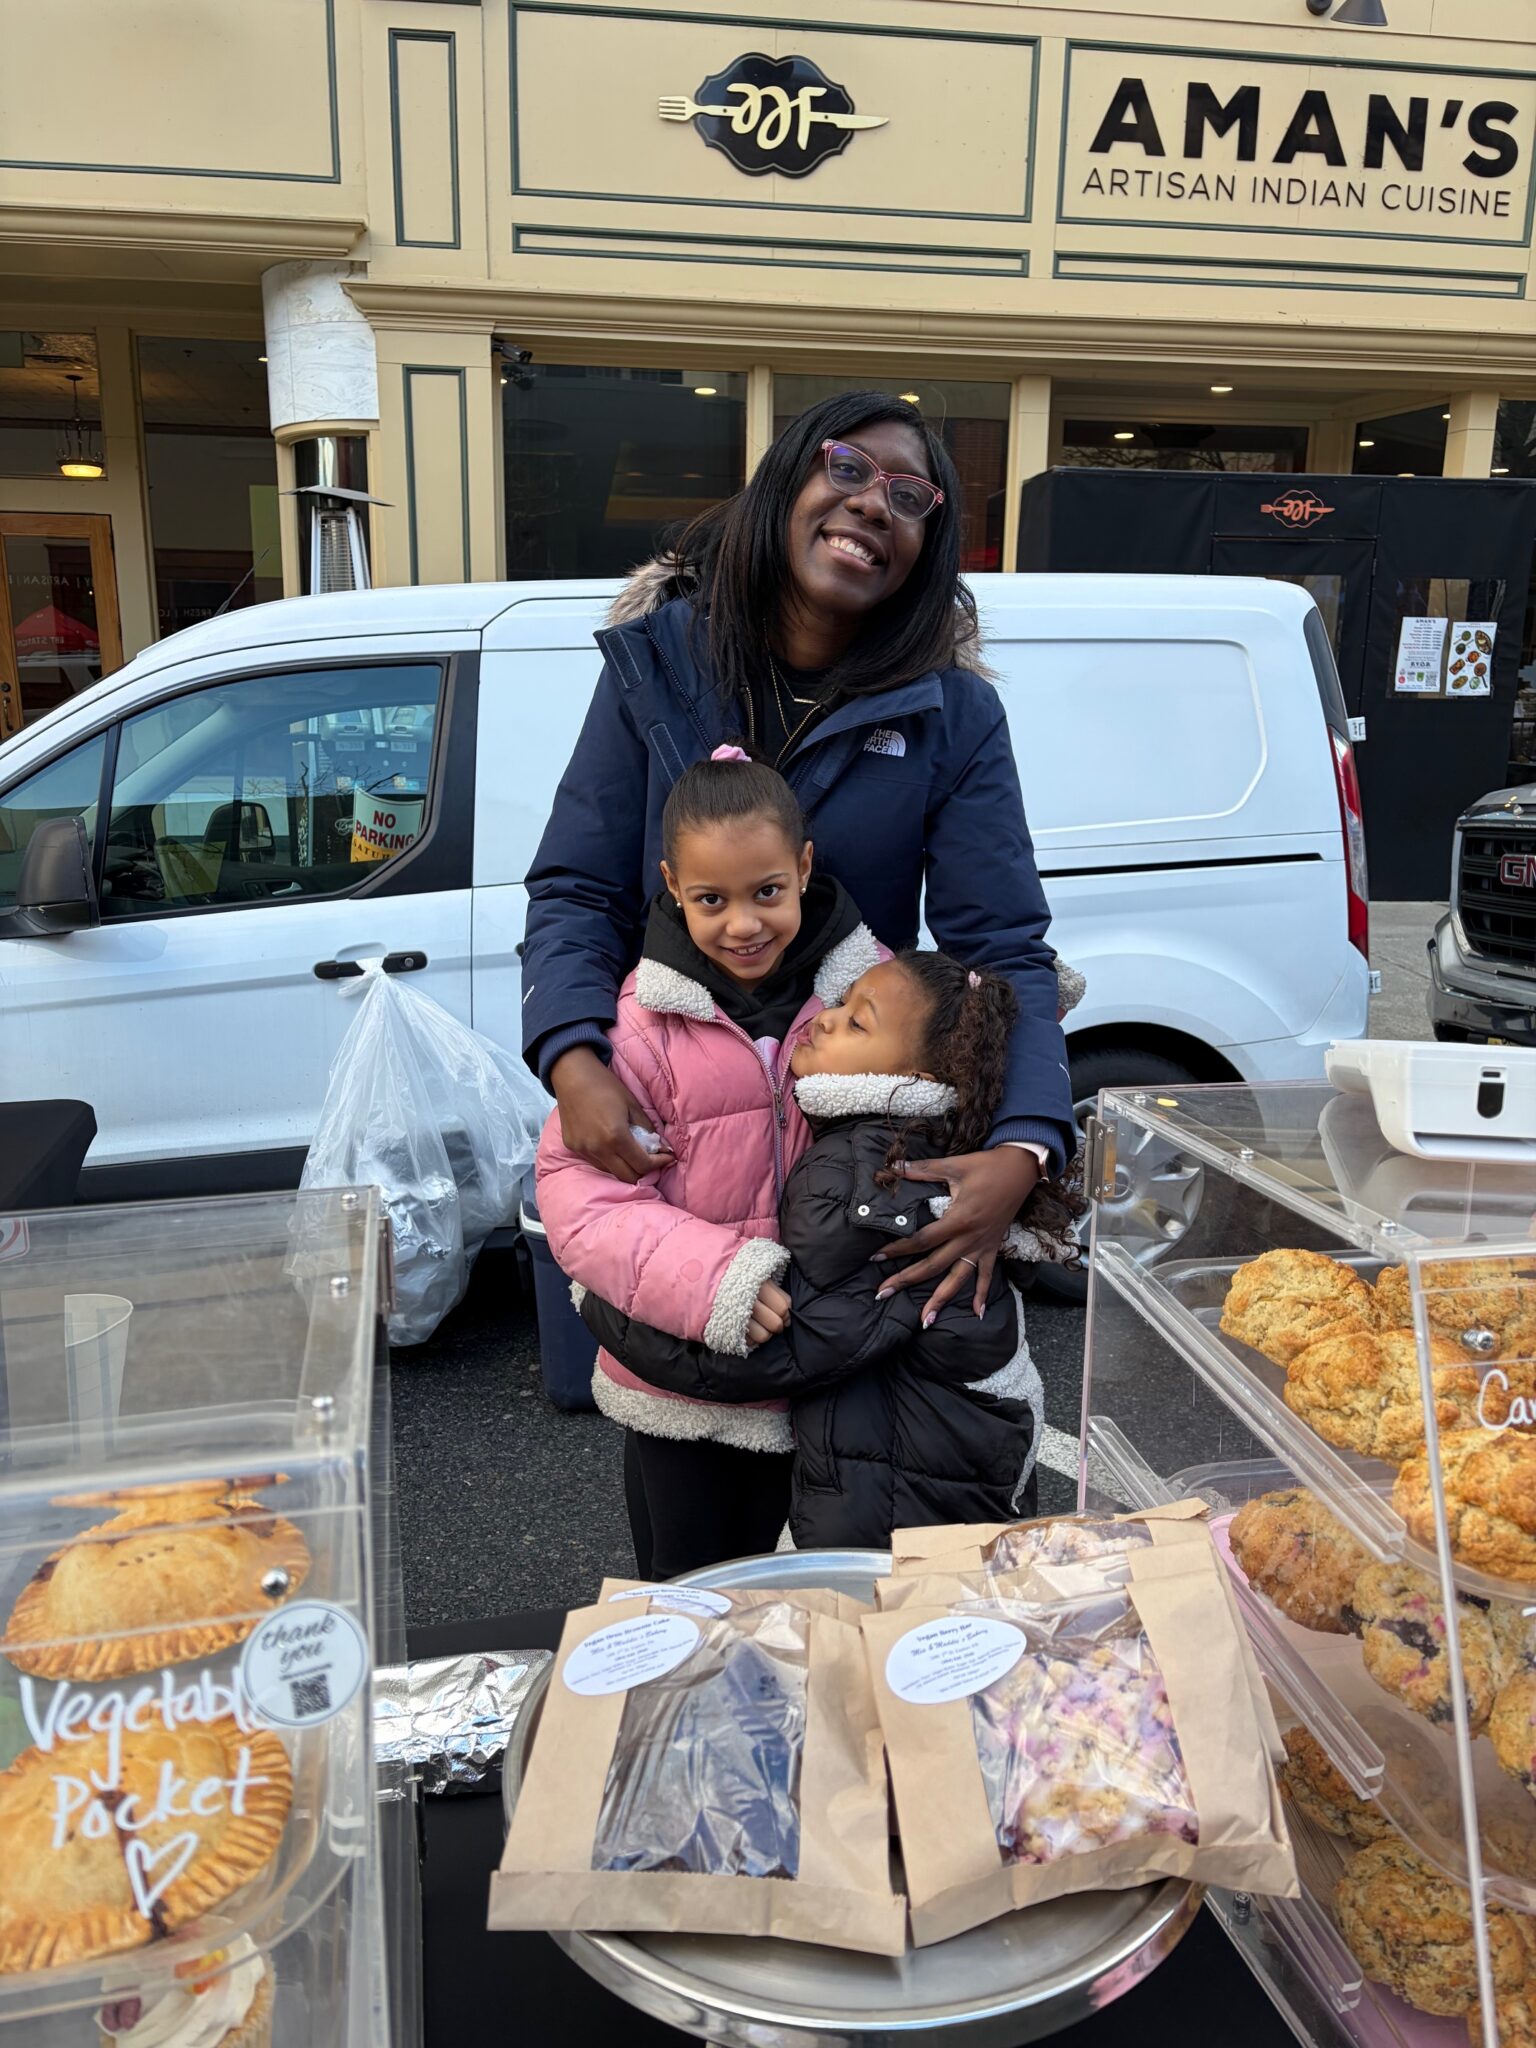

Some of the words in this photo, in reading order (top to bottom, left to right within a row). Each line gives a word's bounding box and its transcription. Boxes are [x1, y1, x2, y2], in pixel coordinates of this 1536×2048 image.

[1088, 77, 1519, 179] AMAN'S
[1082, 166, 1236, 202] ARTISAN
[1251, 175, 1366, 209] INDIAN
[1381, 183, 1512, 218] CUISINE
[863, 744, 889, 755] FACE
[355, 820, 415, 850] PARKING
[373, 810, 397, 829] NO
[261, 1612, 337, 1650] thank
[280, 1641, 324, 1673] you
[51, 1746, 271, 1849] Pocket
